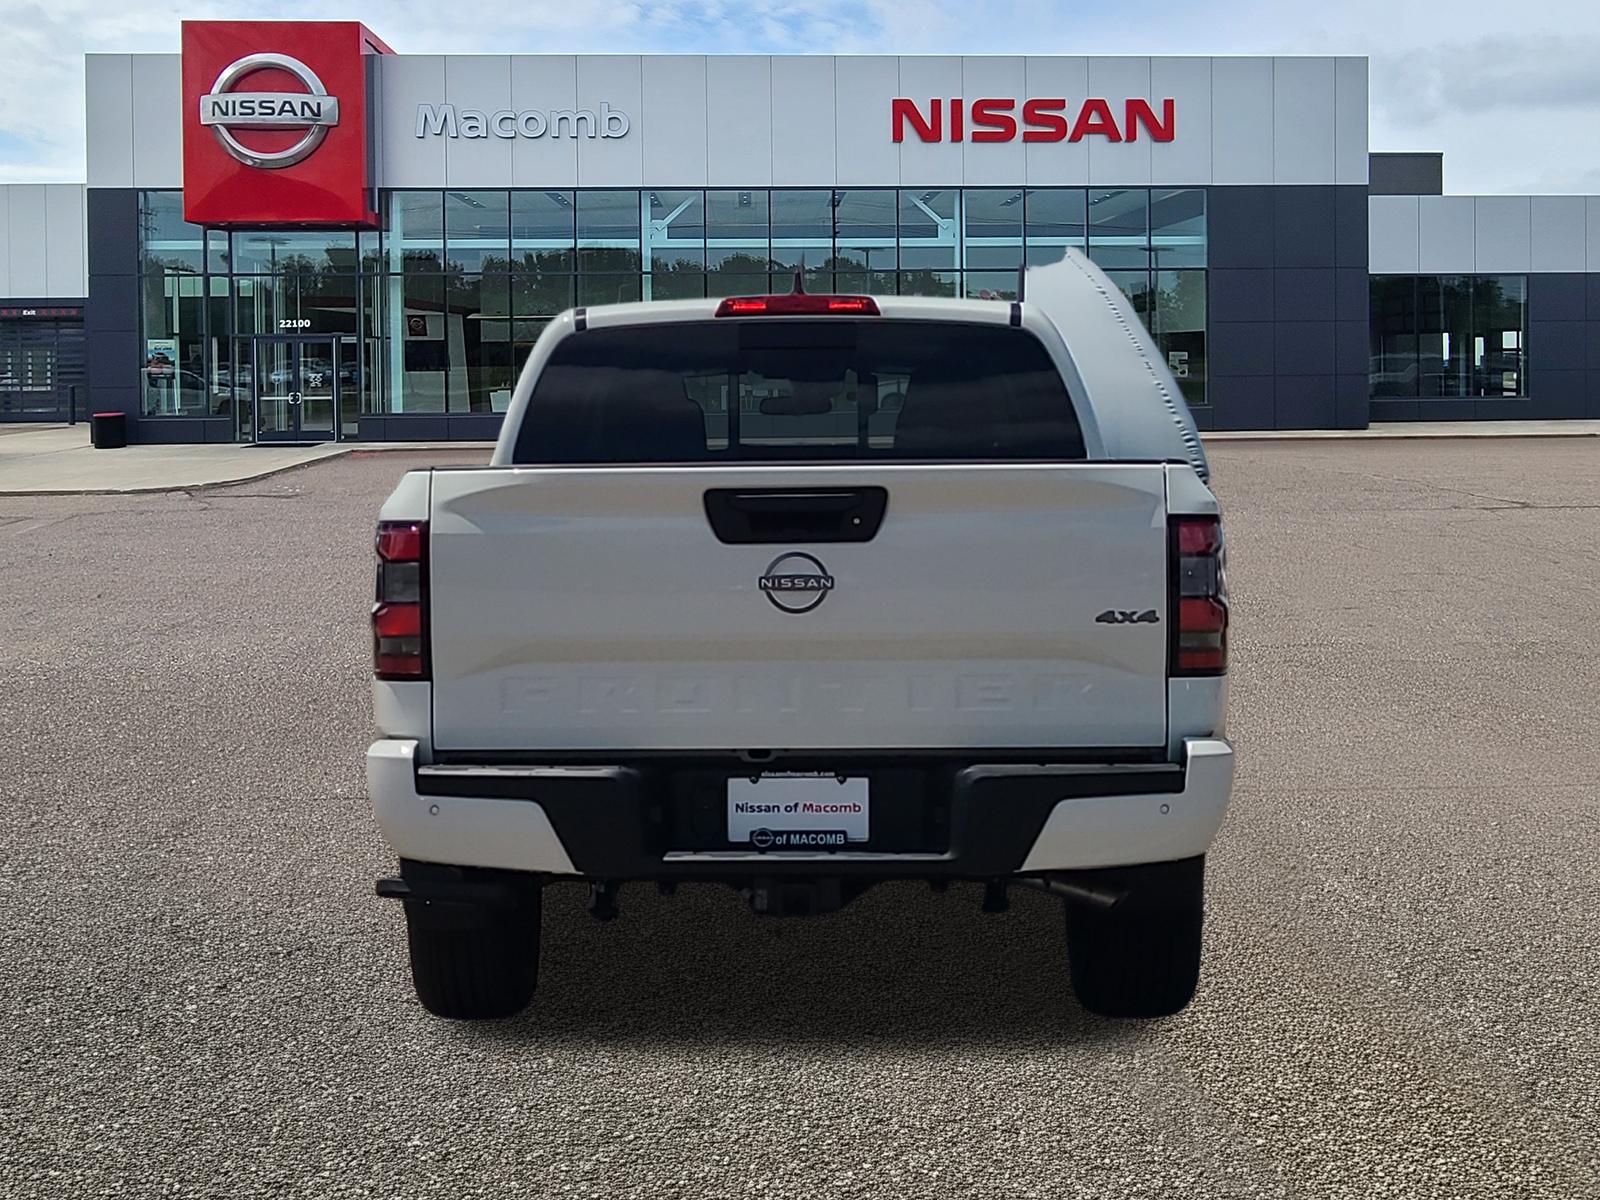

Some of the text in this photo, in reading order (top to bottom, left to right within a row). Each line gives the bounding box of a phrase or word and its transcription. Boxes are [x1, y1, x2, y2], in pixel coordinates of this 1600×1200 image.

[211, 99, 322, 118] NISSAN
[415, 102, 630, 139] Macomb
[891, 98, 1175, 143] NISSAN
[279, 319, 311, 328] 22100
[761, 578, 832, 588] NISSAN
[735, 802, 862, 813] Nissan of Macomb
[775, 834, 788, 844] of
[790, 834, 846, 844] MACOMB
